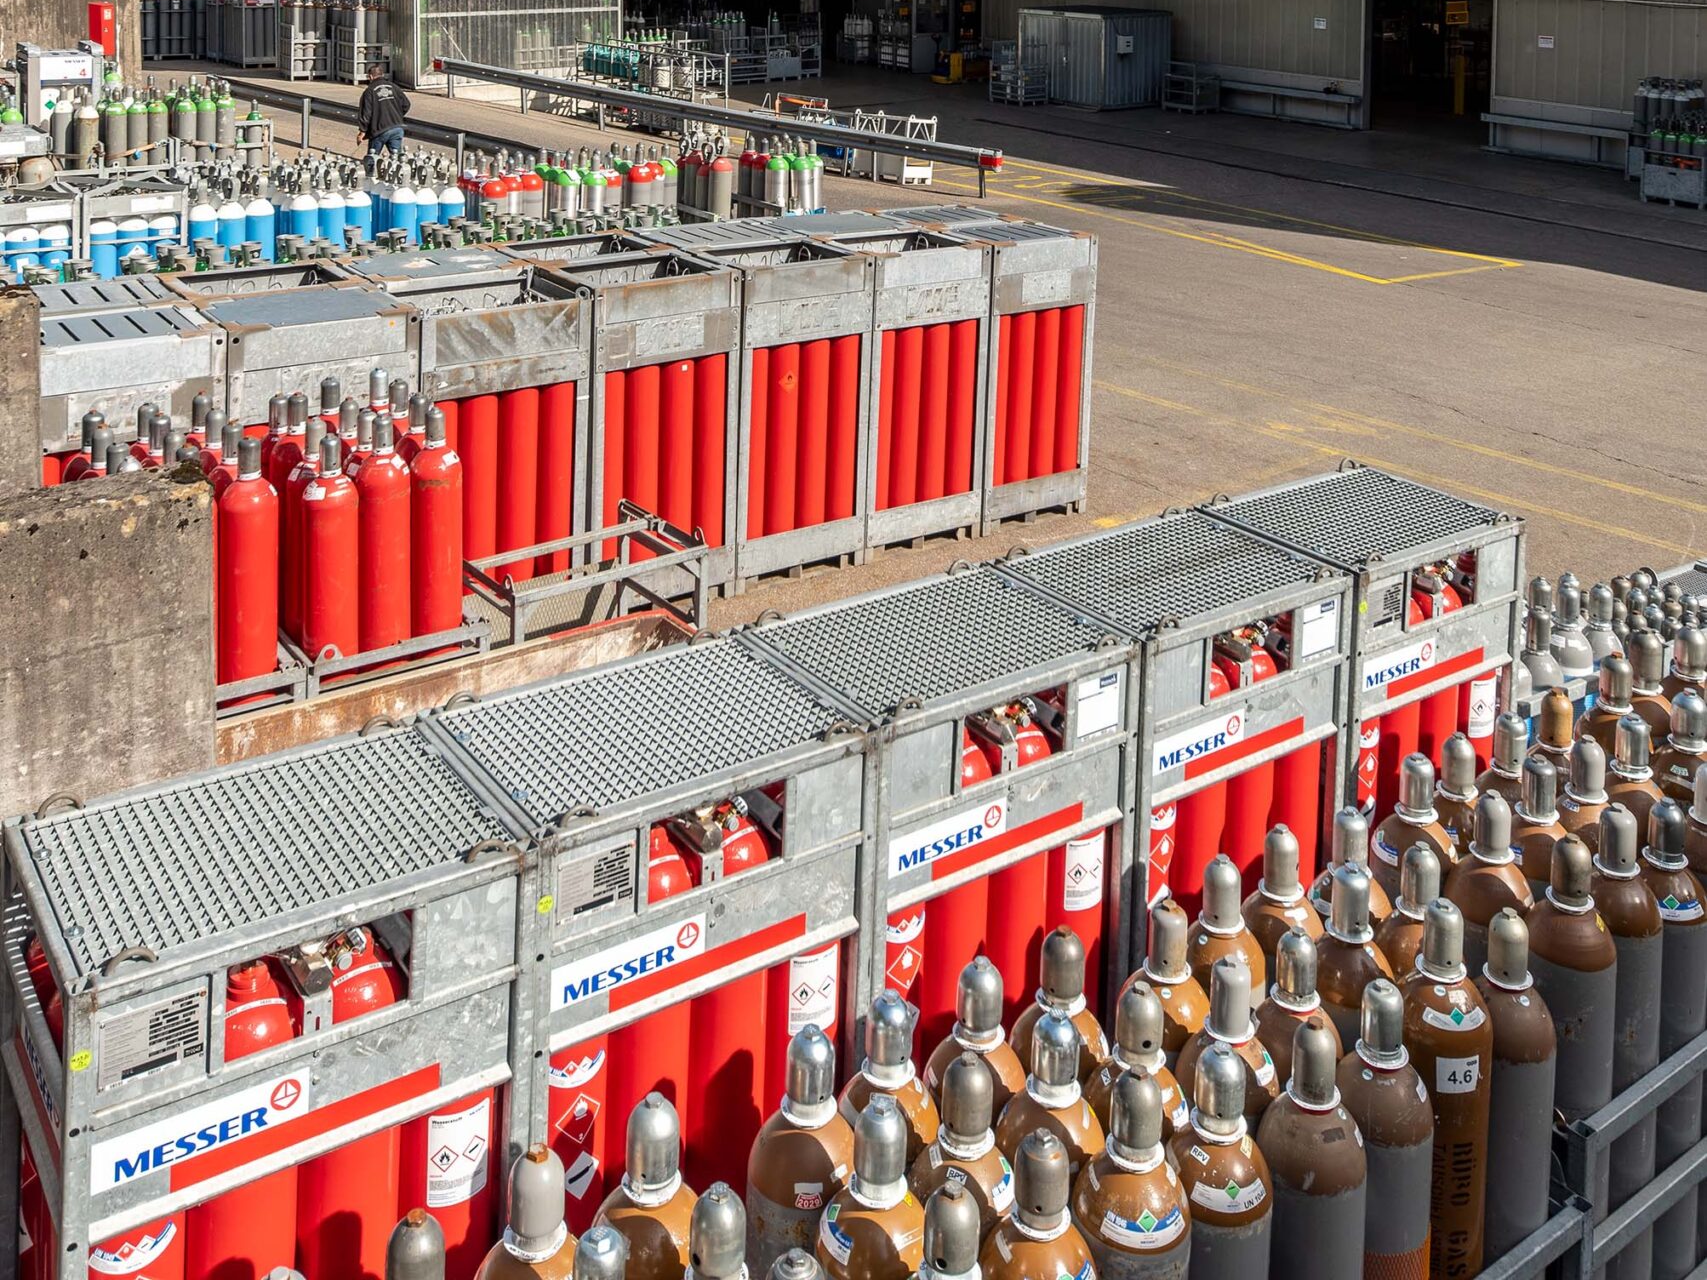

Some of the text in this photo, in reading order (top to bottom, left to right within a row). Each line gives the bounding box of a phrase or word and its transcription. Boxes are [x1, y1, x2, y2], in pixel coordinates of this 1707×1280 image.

[1366, 658, 1420, 689] MESSER
[1159, 732, 1226, 771] MESSER
[898, 824, 983, 872] MESSER
[563, 945, 675, 1004] MESSER
[1447, 1070, 1473, 1085] 4.6
[114, 1107, 268, 1183] MESSER
[1192, 1146, 1209, 1162] RPV
[798, 1198, 821, 1208] 2029
[1243, 1198, 1255, 1210] UN
[1446, 1230, 1469, 1277] GAS
